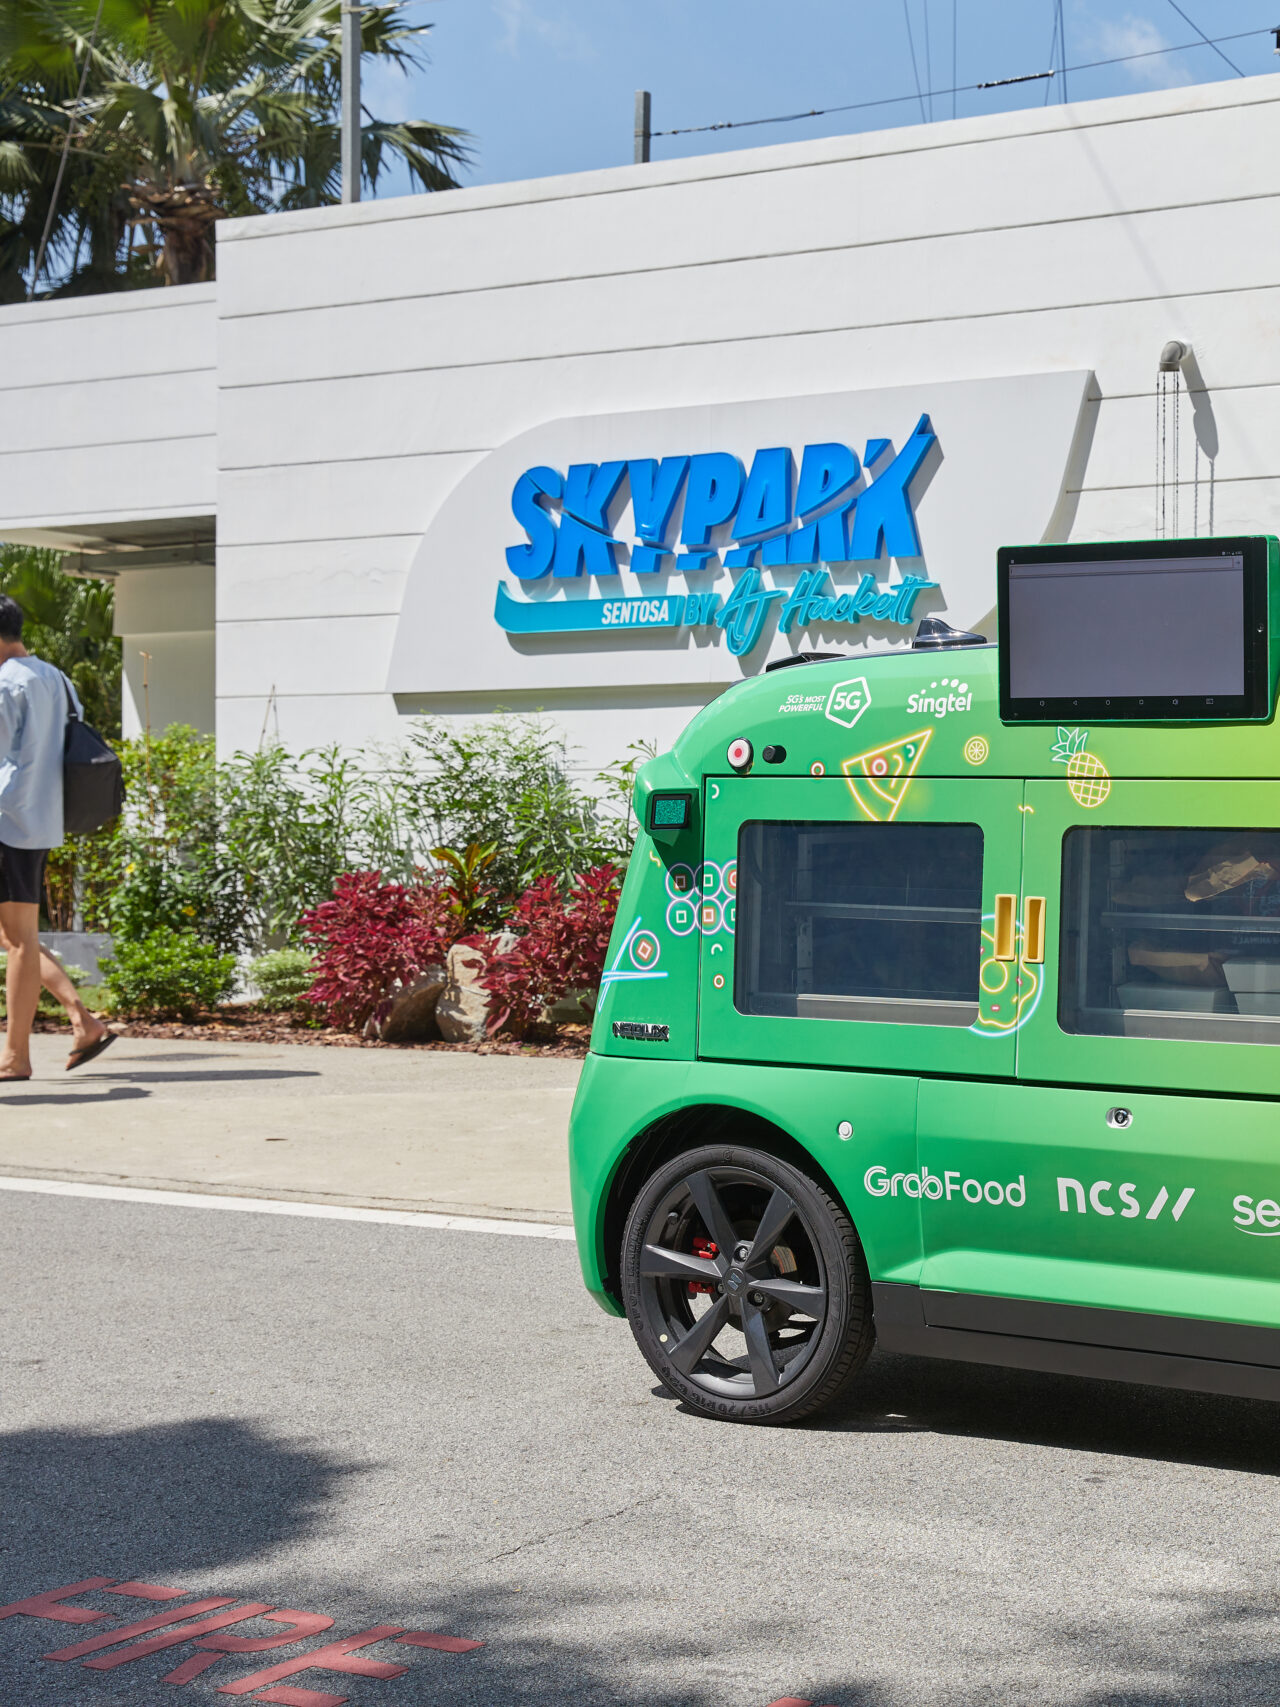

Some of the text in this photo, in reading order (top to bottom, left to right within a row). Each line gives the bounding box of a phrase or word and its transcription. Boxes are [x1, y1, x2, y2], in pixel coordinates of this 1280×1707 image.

[505, 413, 938, 580] SKYPARK
[601, 600, 669, 625] SENTOSA
[683, 592, 716, 627] BY
[779, 569, 940, 634] Hackett
[778, 703, 824, 713] POWERFUL
[804, 695, 826, 704] MOST
[833, 691, 862, 711] 5G
[906, 689, 973, 718] Singtel
[863, 1165, 1027, 1208] GrabFood
[0, 1576, 487, 1707] FIRE
